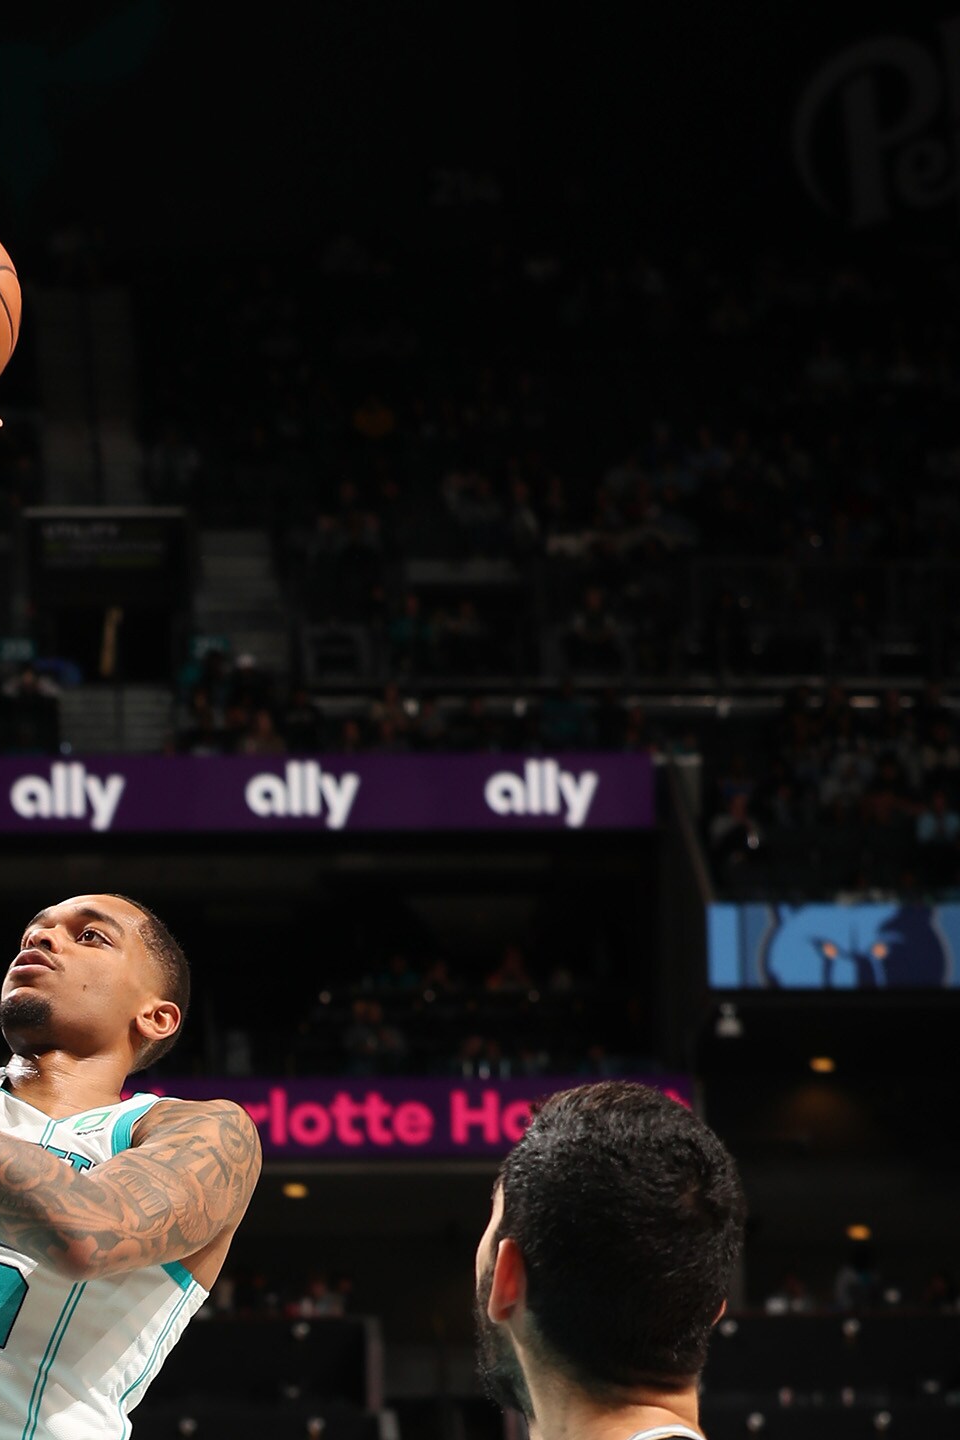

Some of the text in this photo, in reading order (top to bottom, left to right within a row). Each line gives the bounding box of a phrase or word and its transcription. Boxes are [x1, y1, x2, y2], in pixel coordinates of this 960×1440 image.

[790, 18, 960, 231] Pe
[10, 763, 125, 831] ally
[246, 761, 360, 829] ally
[485, 759, 598, 828] ally
[244, 1085, 435, 1147] rlotte
